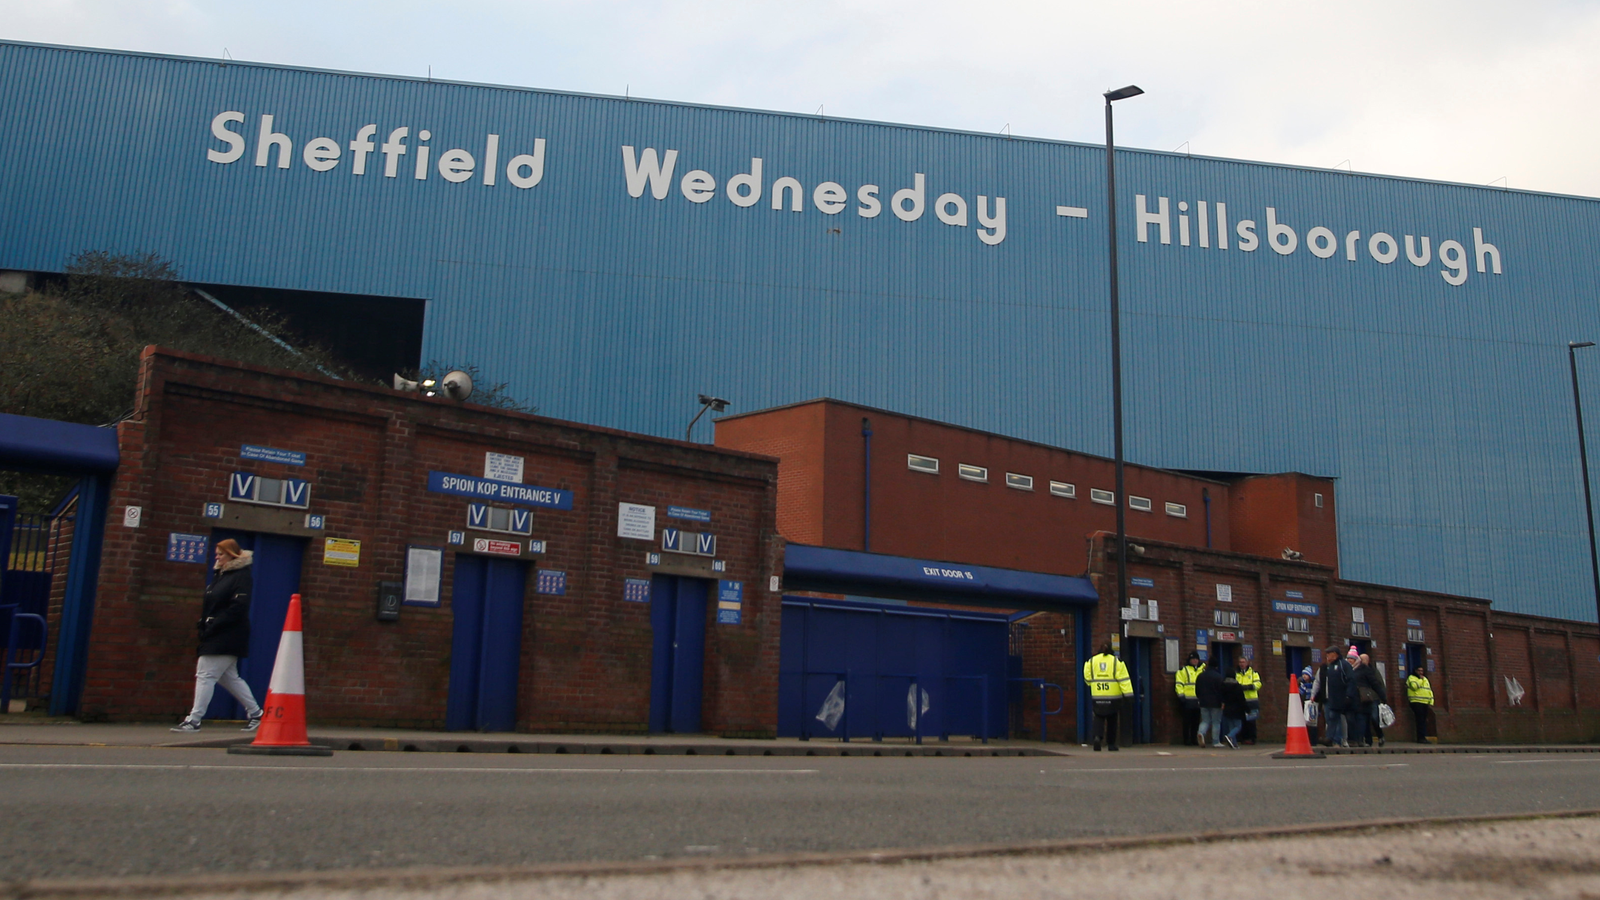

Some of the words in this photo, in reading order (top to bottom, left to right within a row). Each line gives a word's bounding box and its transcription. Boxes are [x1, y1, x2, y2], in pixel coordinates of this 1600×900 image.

[207, 110, 546, 189] Sheffield
[621, 145, 1007, 245] Wednesday
[1135, 194, 1502, 286] Hillsborough
[493, 473, 514, 481] EJECTED
[236, 474, 254, 496] V
[289, 481, 305, 502] V
[442, 476, 475, 493] SPION
[477, 482, 499, 496] KOP
[500, 486, 552, 504] ENTRANCE
[554, 493, 561, 504] V
[208, 505, 218, 516] 55
[472, 505, 486, 524] V
[515, 510, 528, 529] V
[311, 517, 321, 527] 56
[452, 533, 460, 543] 57
[665, 530, 677, 548] V
[701, 534, 712, 552] V
[923, 567, 941, 576] EXIT
[942, 569, 964, 579] DOOR
[964, 572, 974, 580] 15
[1097, 682, 1110, 691] S15
